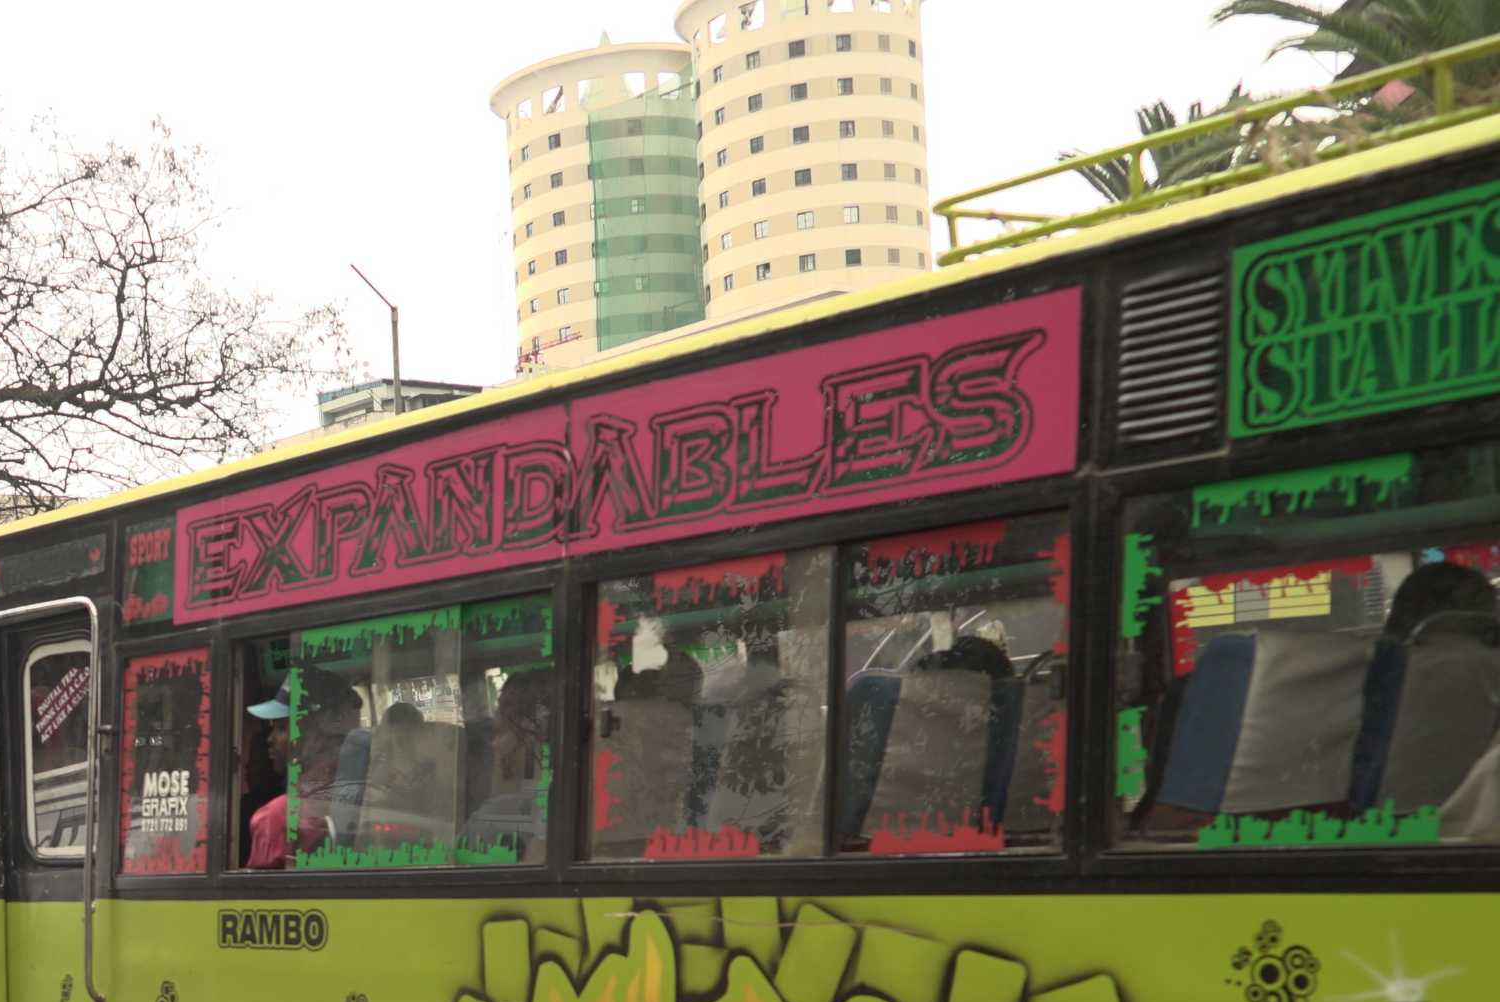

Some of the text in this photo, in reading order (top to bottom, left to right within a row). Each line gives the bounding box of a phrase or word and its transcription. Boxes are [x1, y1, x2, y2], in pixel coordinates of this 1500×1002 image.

[185, 329, 1047, 609] EXPANDABLES
[143, 770, 190, 797] MOSE
[142, 797, 189, 817] GRAFIX
[219, 911, 327, 949] RAMBO
